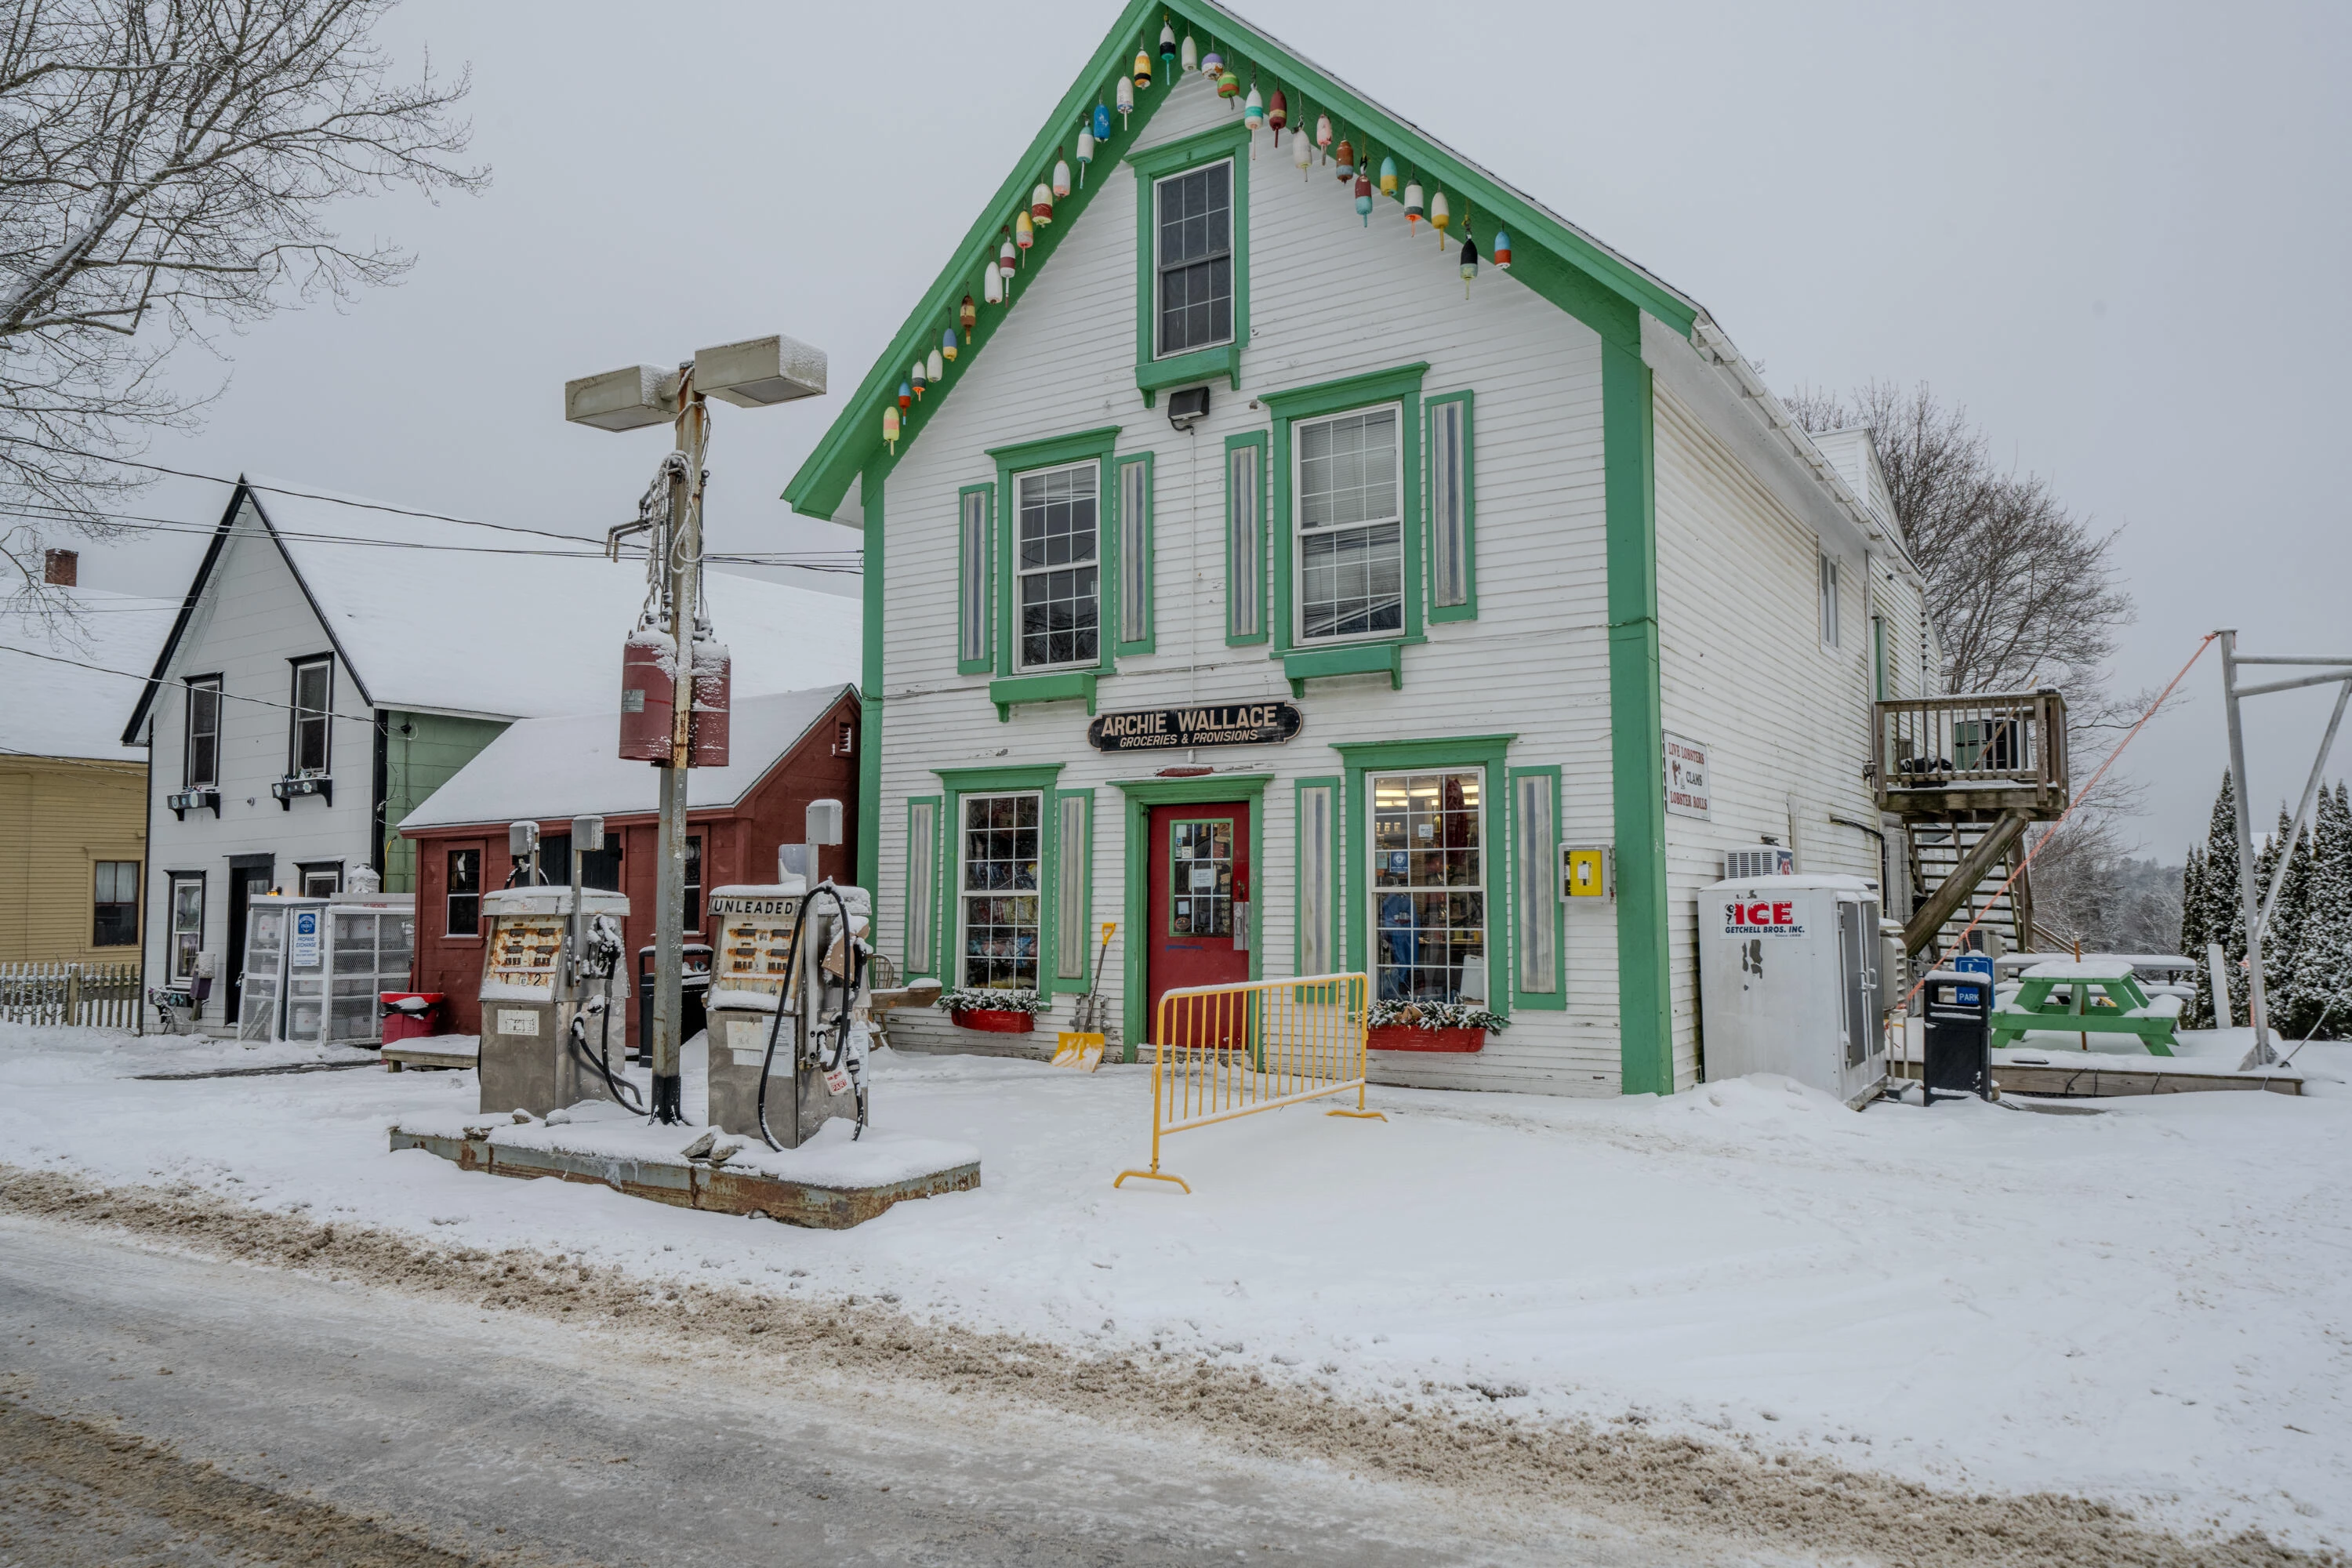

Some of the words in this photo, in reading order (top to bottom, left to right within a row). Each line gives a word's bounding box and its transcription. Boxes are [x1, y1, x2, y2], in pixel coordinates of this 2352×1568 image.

[1101, 713, 1167, 737] ARCHIE
[1178, 706, 1278, 732] WALLACE
[1120, 734, 1178, 748] GROCERIES
[1181, 733, 1189, 743] &
[1192, 729, 1258, 744] PROVISIONS
[1668, 742, 1680, 757] LIVE
[1681, 746, 1704, 765] LOBSTERS
[1686, 771, 1703, 786] CLAMS
[1670, 790, 1692, 808] LOBSTER
[1693, 796, 1708, 810] ROLLS
[714, 899, 793, 914] UNLEADED
[1734, 901, 1793, 925] ICE
[533, 973, 541, 985] 2
